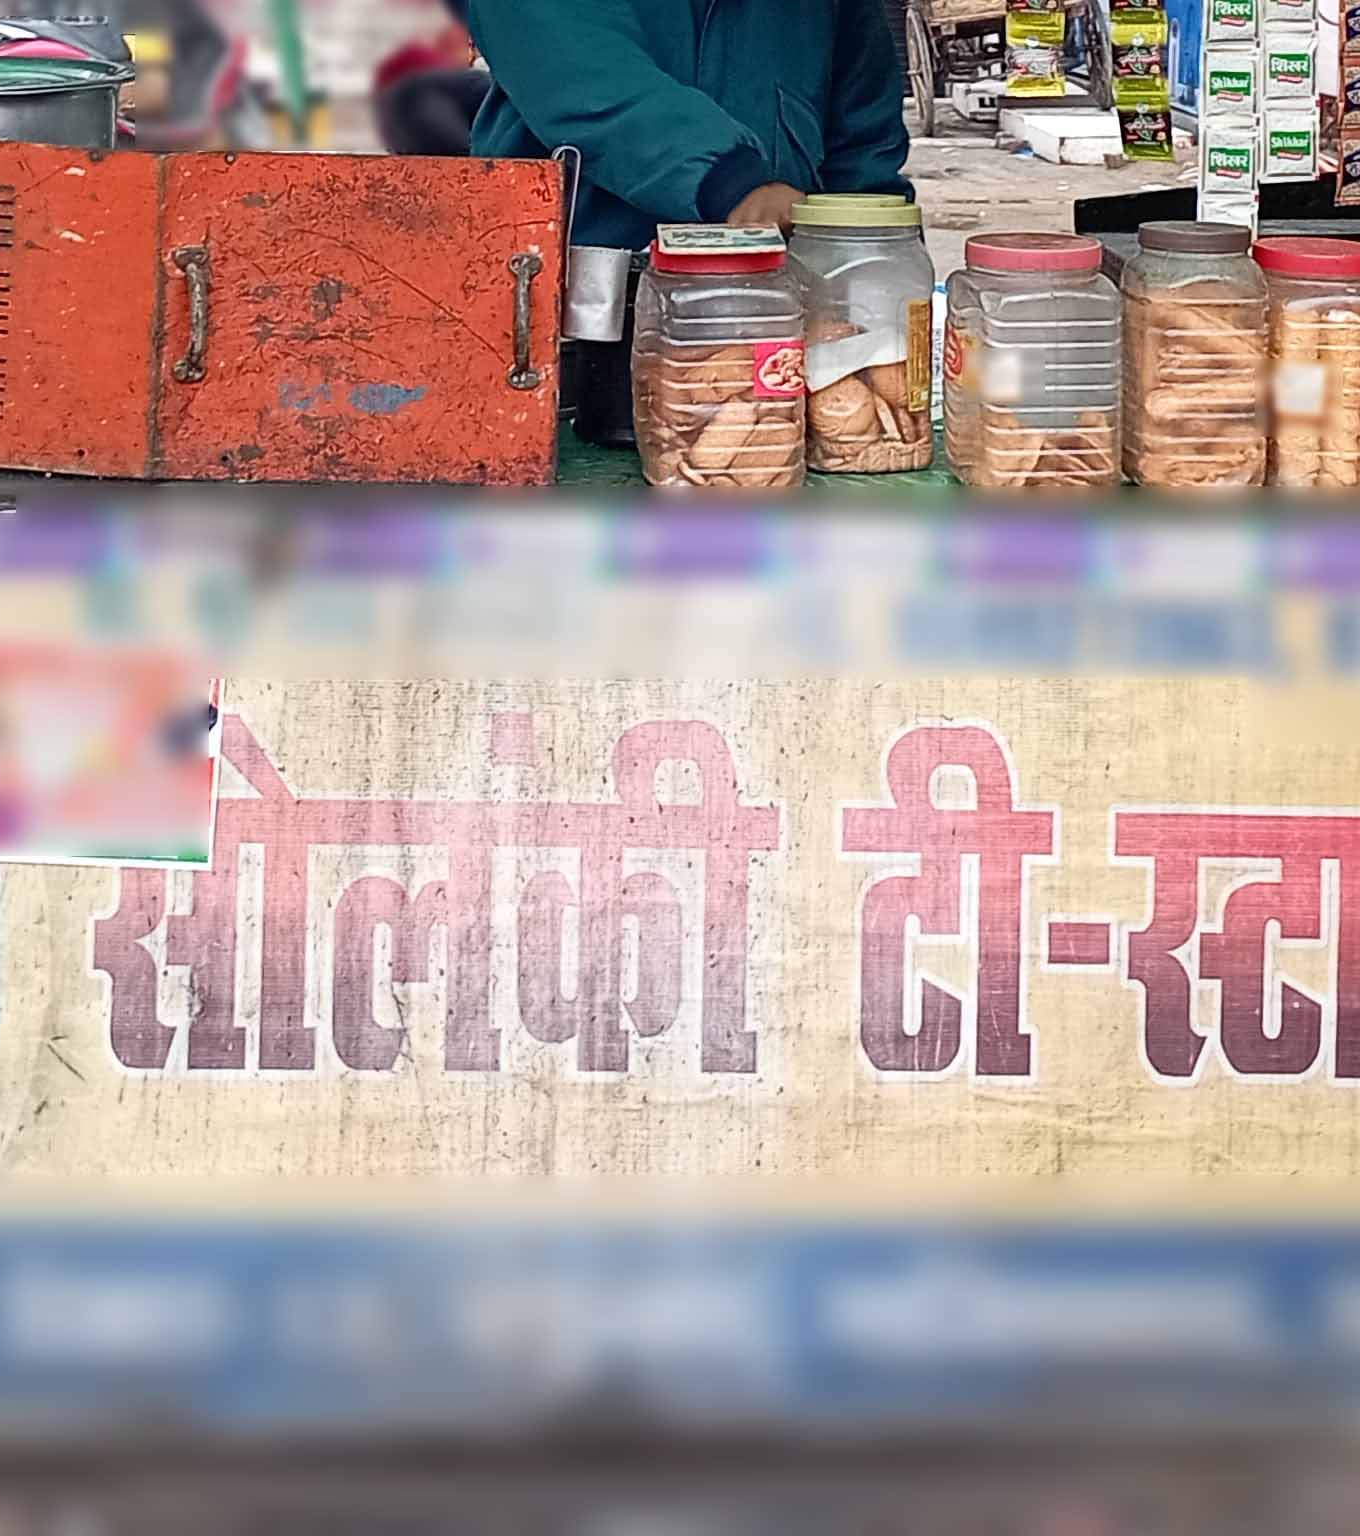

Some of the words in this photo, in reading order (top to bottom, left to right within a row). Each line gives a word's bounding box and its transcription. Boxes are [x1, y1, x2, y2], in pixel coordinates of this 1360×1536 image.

[1215, 0, 1252, 16] शिखर
[1271, 57, 1310, 72] शिखर
[1210, 76, 1250, 89] Shikhar
[1271, 135, 1310, 148] Shikhar
[1210, 151, 1248, 166] शिखर
